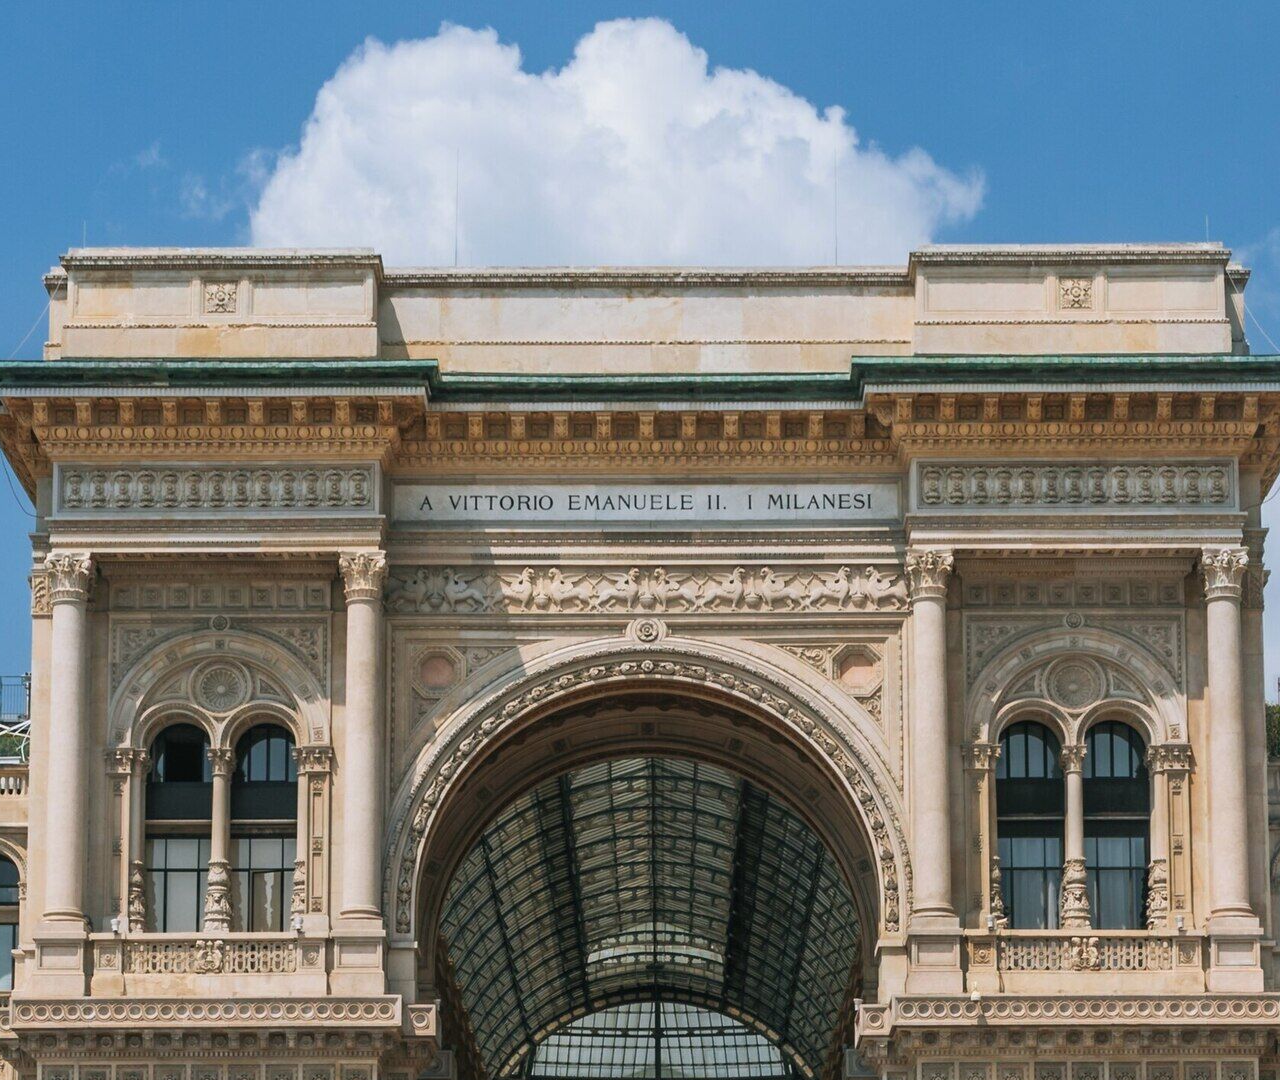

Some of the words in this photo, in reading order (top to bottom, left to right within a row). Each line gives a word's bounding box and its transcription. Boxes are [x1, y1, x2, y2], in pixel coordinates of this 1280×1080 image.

[419, 494, 434, 511] A
[448, 494, 554, 511] VITTORIO
[567, 494, 694, 511] EMANUELE
[748, 494, 753, 510] I
[767, 493, 873, 510] MILANESI
